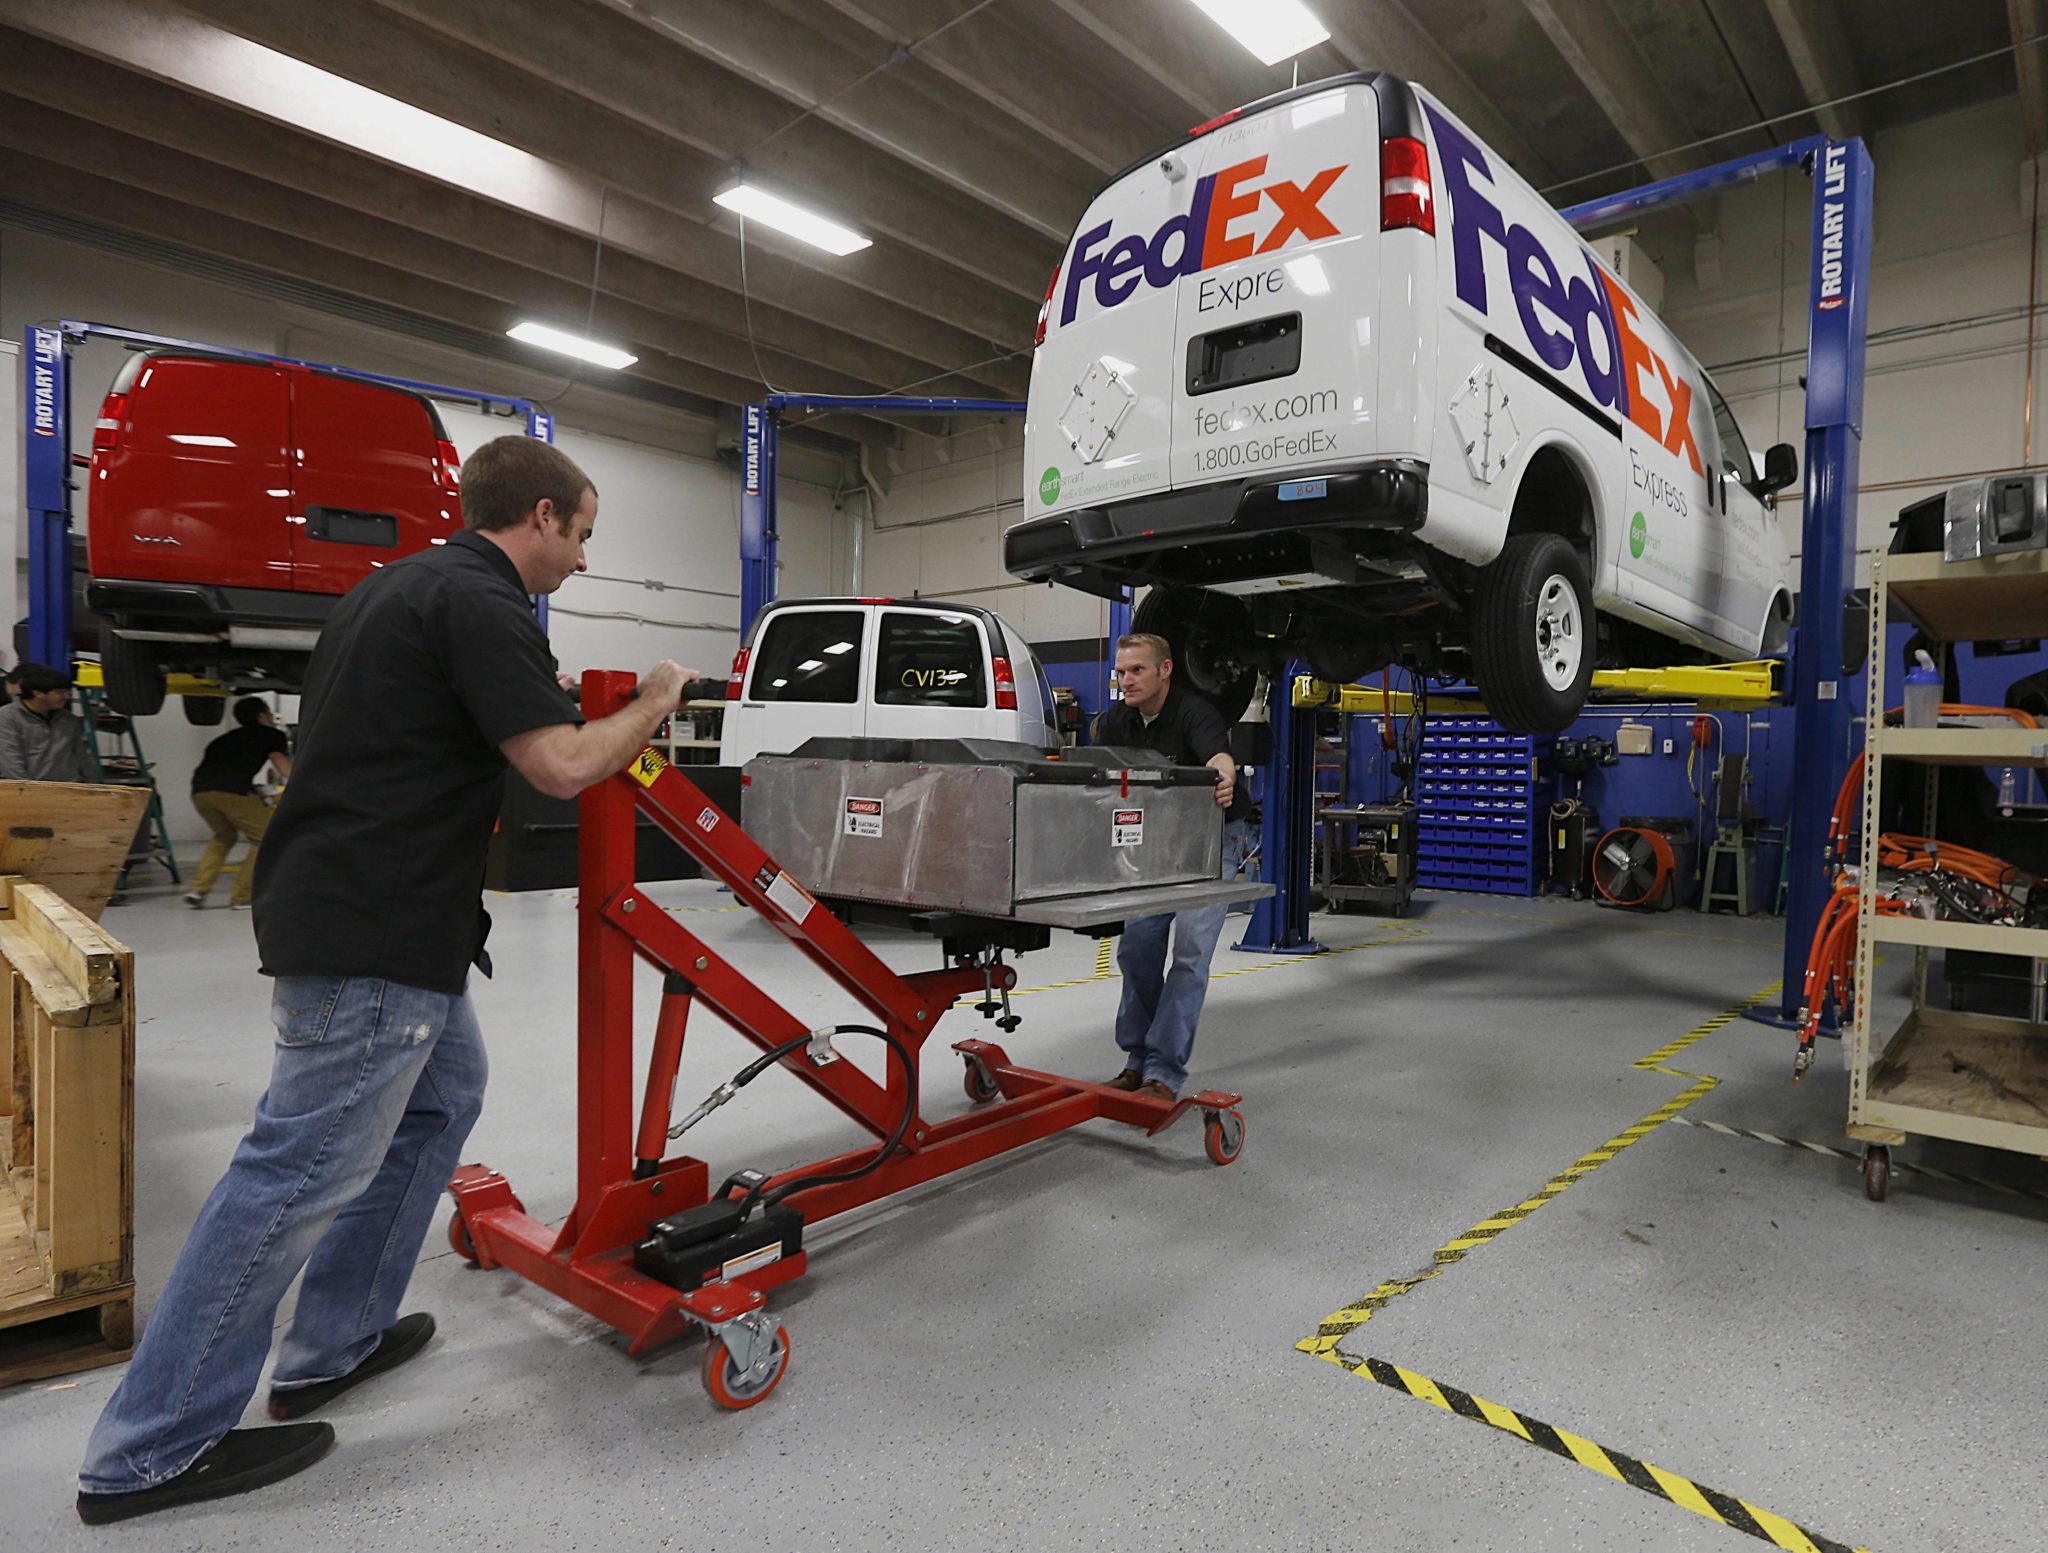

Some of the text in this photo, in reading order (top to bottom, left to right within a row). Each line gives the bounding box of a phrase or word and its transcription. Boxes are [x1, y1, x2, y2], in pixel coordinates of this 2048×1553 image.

[1059, 153, 1350, 328] FedEx
[1821, 145, 1847, 298] ROTARY LIFT
[1198, 267, 1288, 313] Expre
[1421, 97, 1706, 480] FedEx
[34, 328, 54, 429] ROTARY LIFT
[746, 405, 760, 489] ROTARY LIFT
[1193, 429, 1338, 473] 1.800.GoFedEx
[1110, 476, 1132, 490] Range
[1132, 472, 1160, 482] Electric
[1629, 447, 1688, 517] Express
[901, 668, 960, 687] CV135
[850, 802, 877, 811] DANGER
[1119, 813, 1139, 822] DANGER
